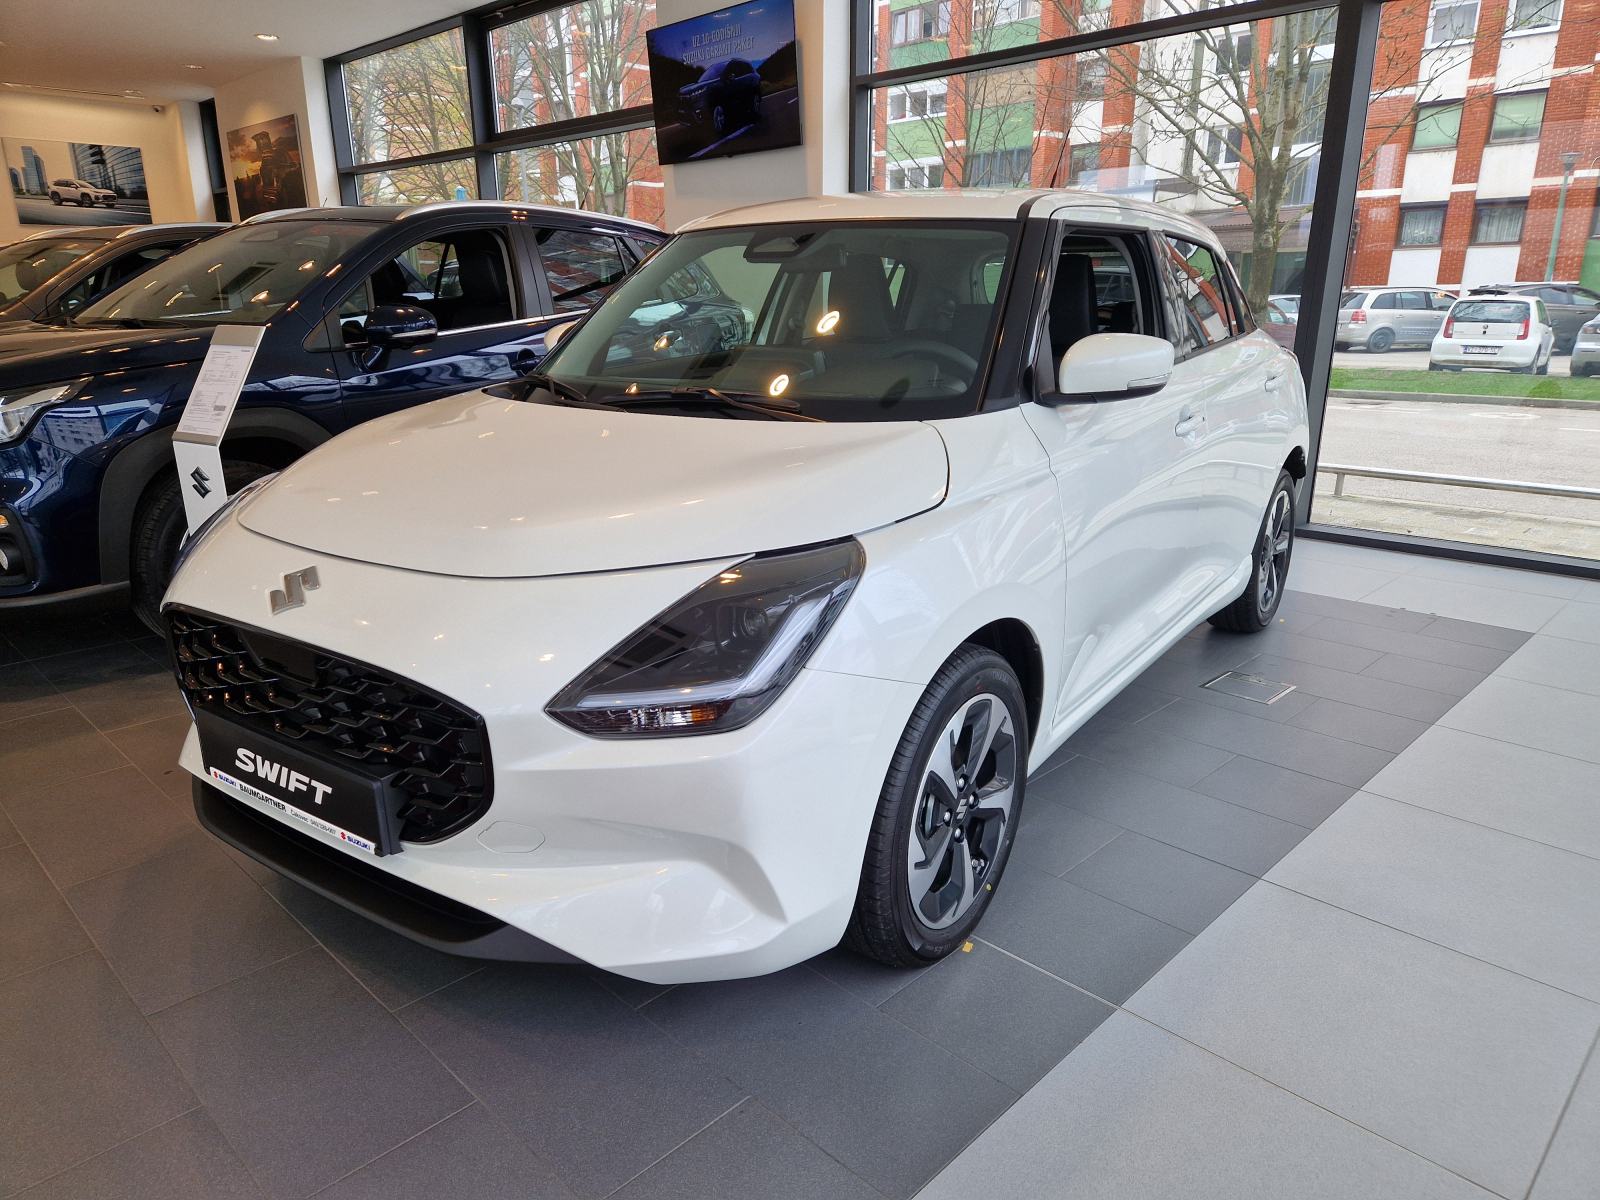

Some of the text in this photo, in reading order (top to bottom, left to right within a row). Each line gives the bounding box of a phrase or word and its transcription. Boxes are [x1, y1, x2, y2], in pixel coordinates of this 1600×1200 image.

[235, 747, 333, 805] SWIFT
[218, 774, 237, 787] SUZUKI
[347, 835, 371, 851] SUZUKI
